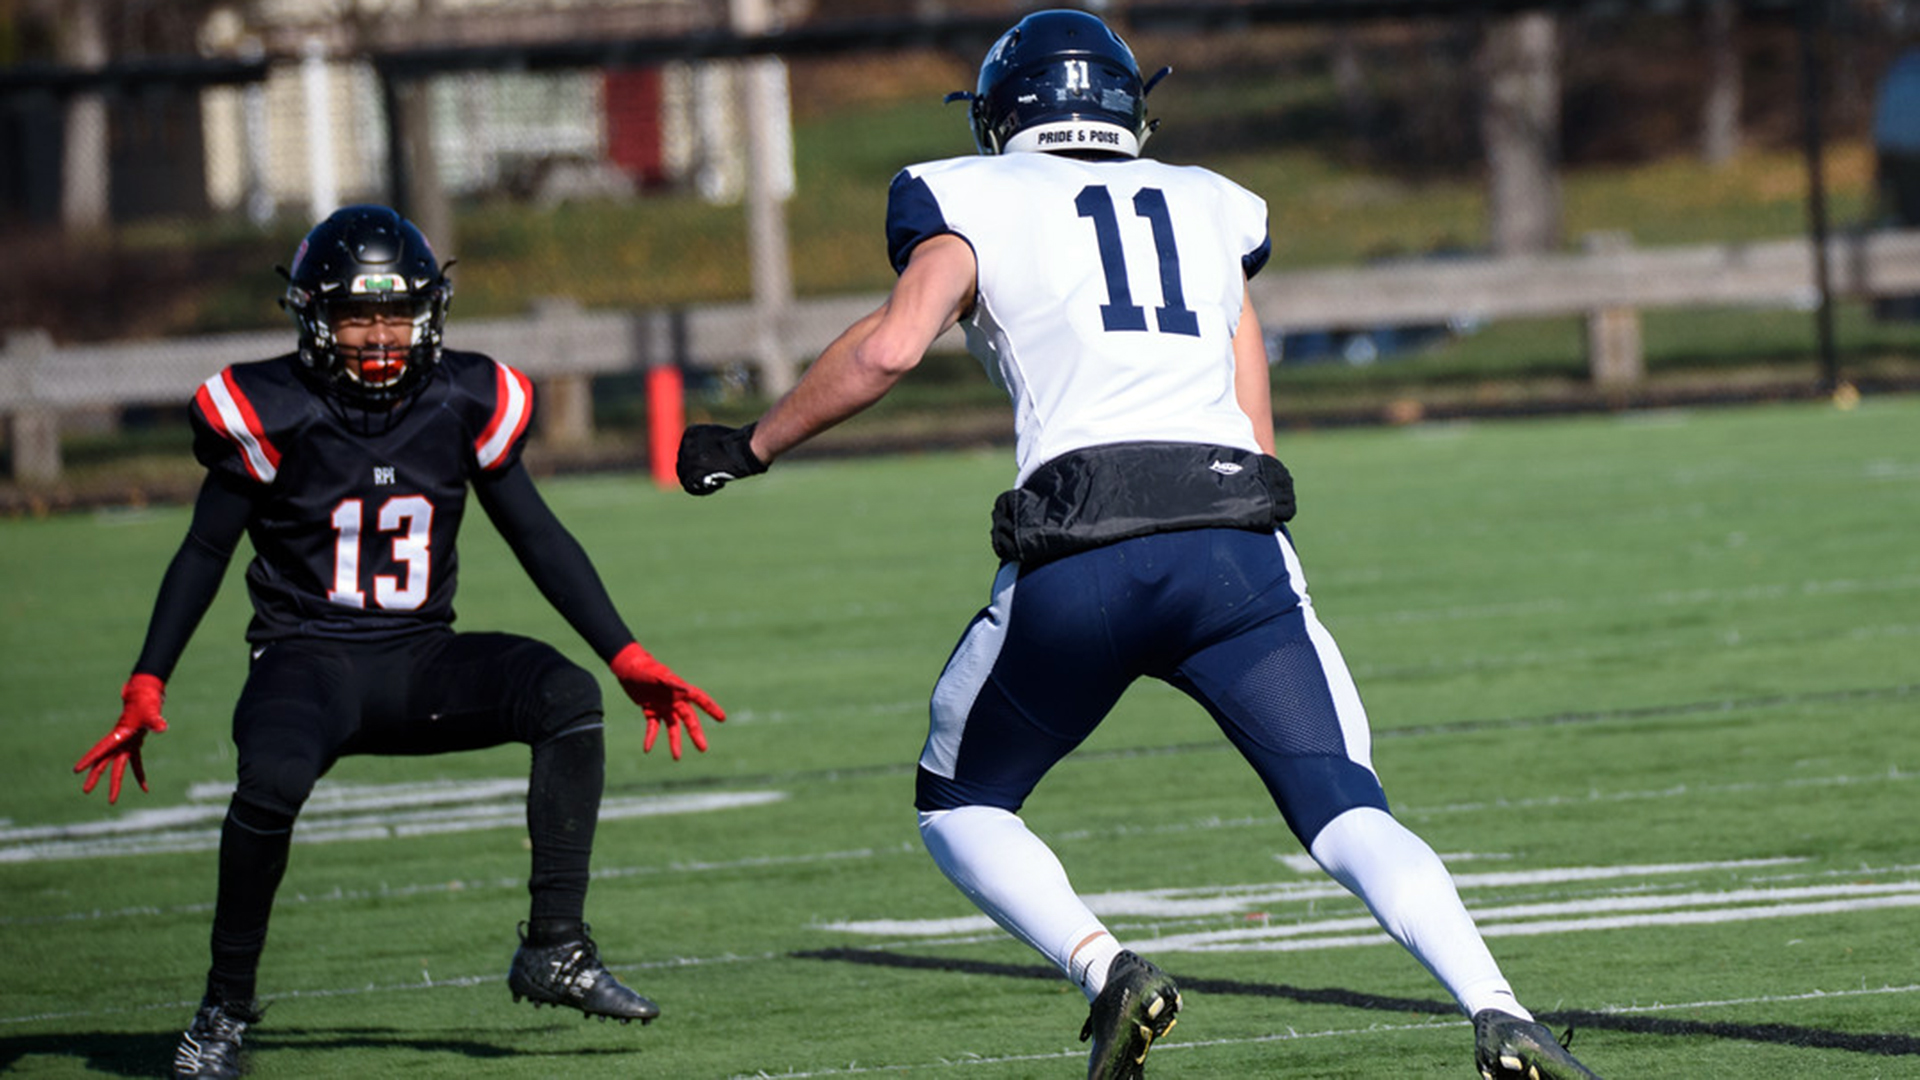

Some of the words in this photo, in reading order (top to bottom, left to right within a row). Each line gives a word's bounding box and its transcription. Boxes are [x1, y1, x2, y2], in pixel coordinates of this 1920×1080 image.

[1064, 61, 1090, 90] 11
[1038, 130, 1073, 145] PRIDE
[1077, 129, 1086, 142] &
[1089, 130, 1119, 145] POISE
[1074, 184, 1201, 337] 11
[373, 467, 395, 485] RPI
[327, 495, 434, 610] 13
